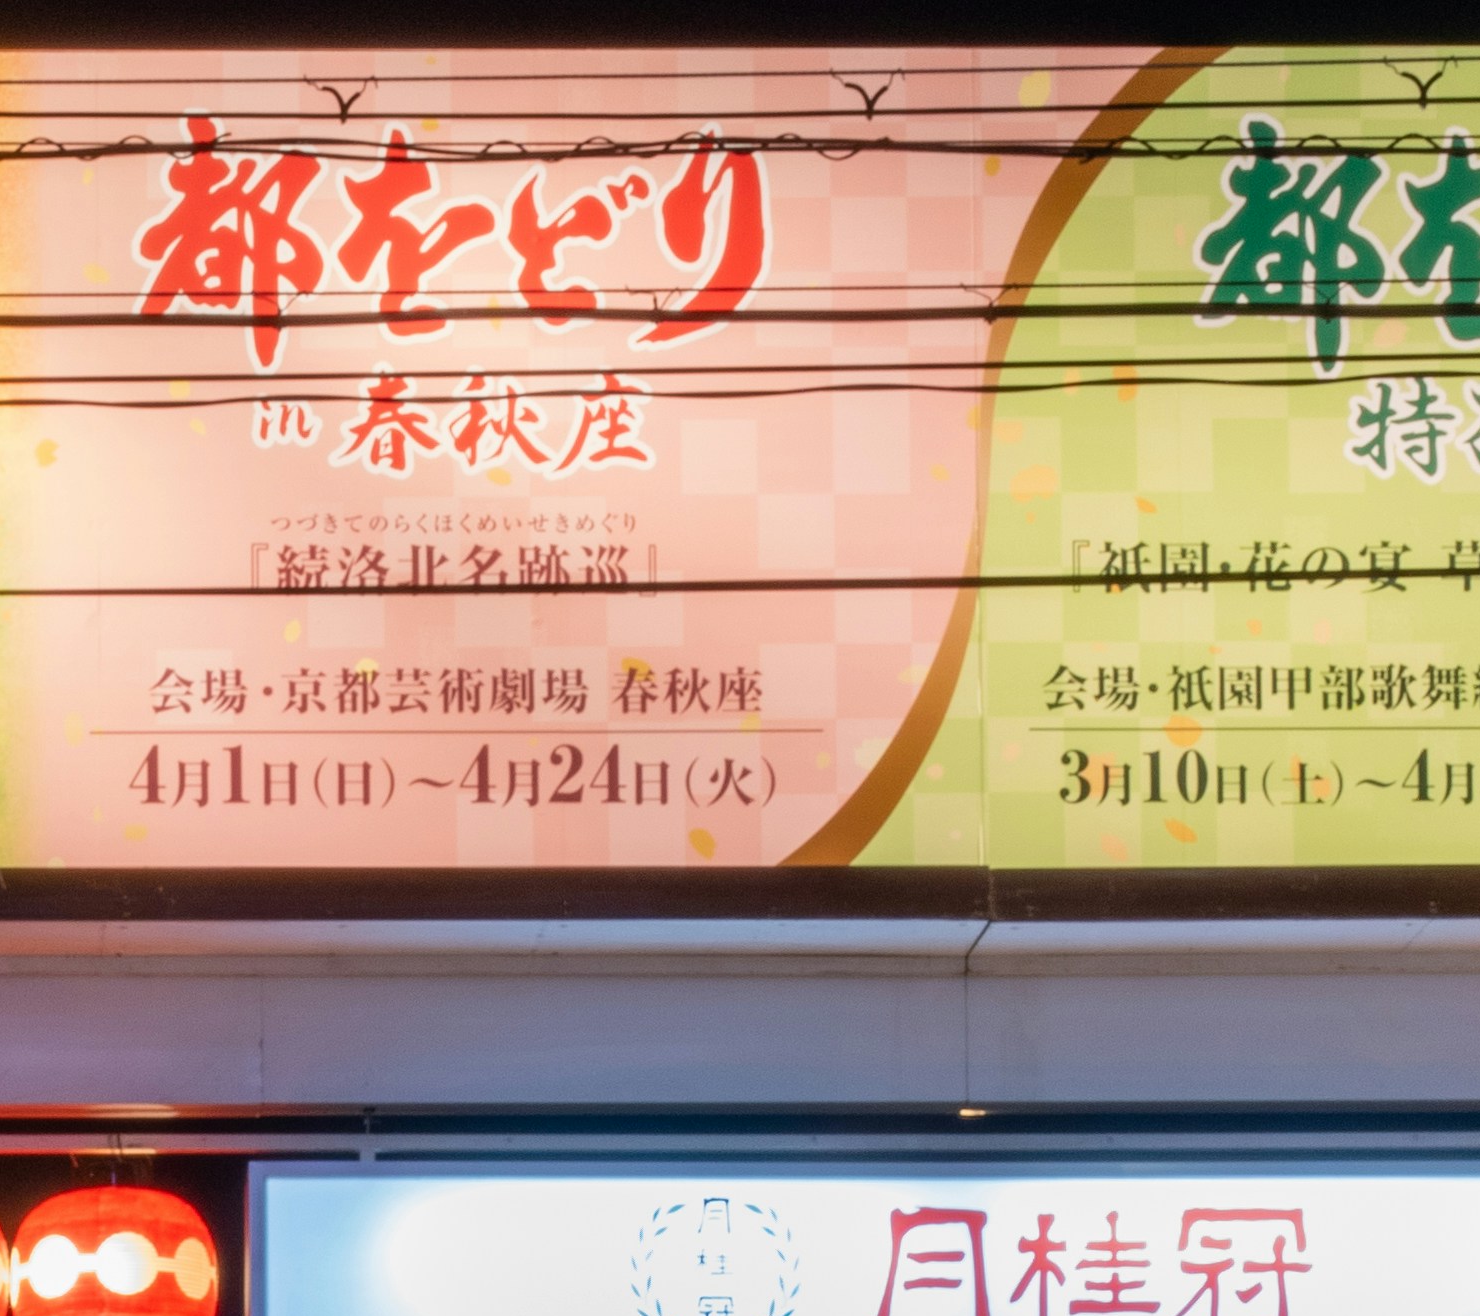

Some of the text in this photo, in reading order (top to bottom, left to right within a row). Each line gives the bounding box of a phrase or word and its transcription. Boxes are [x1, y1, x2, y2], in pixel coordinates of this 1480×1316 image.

[134, 112, 767, 368] 都をどり
[259, 371, 649, 472] in 春秋座
[270, 513, 639, 535] つづきてのらくほくめいせきめぐり
[148, 666, 765, 715] 会場・京都芸術劇場 春秋座
